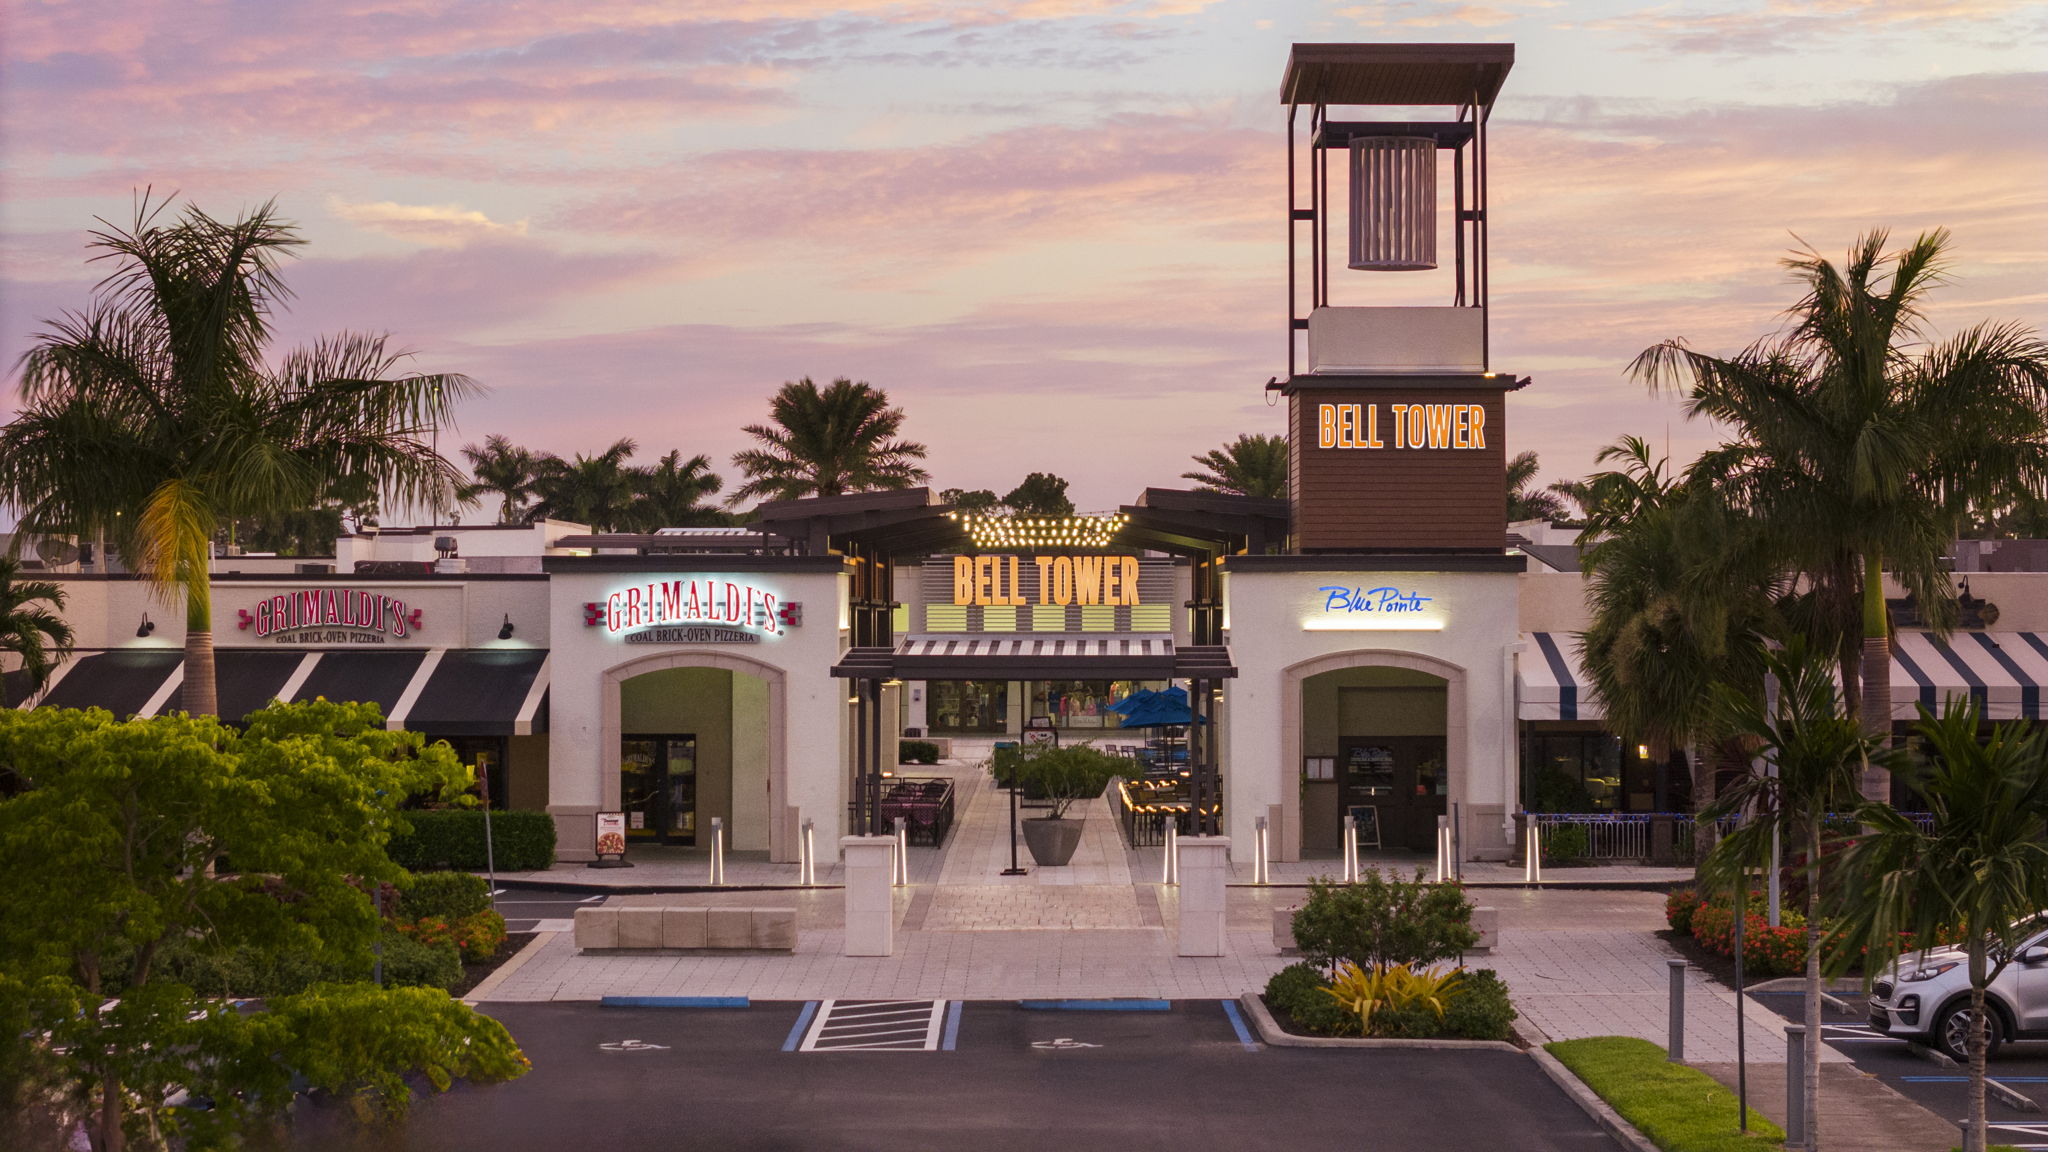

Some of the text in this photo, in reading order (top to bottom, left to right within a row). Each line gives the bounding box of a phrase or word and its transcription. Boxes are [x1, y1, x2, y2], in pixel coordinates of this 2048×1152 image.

[1319, 404, 1486, 449] BELL TOWER
[954, 556, 1140, 606] BELL TOWER
[1318, 586, 1433, 613] Blue Pointe
[255, 589, 406, 637] GRIMALDI'S
[606, 579, 778, 634] GRIMALDI'S
[276, 631, 385, 644] COAL BRICK-OVEN PIZZERIA
[630, 628, 755, 642] COAL BRICK-OVEN PIZZERIA
